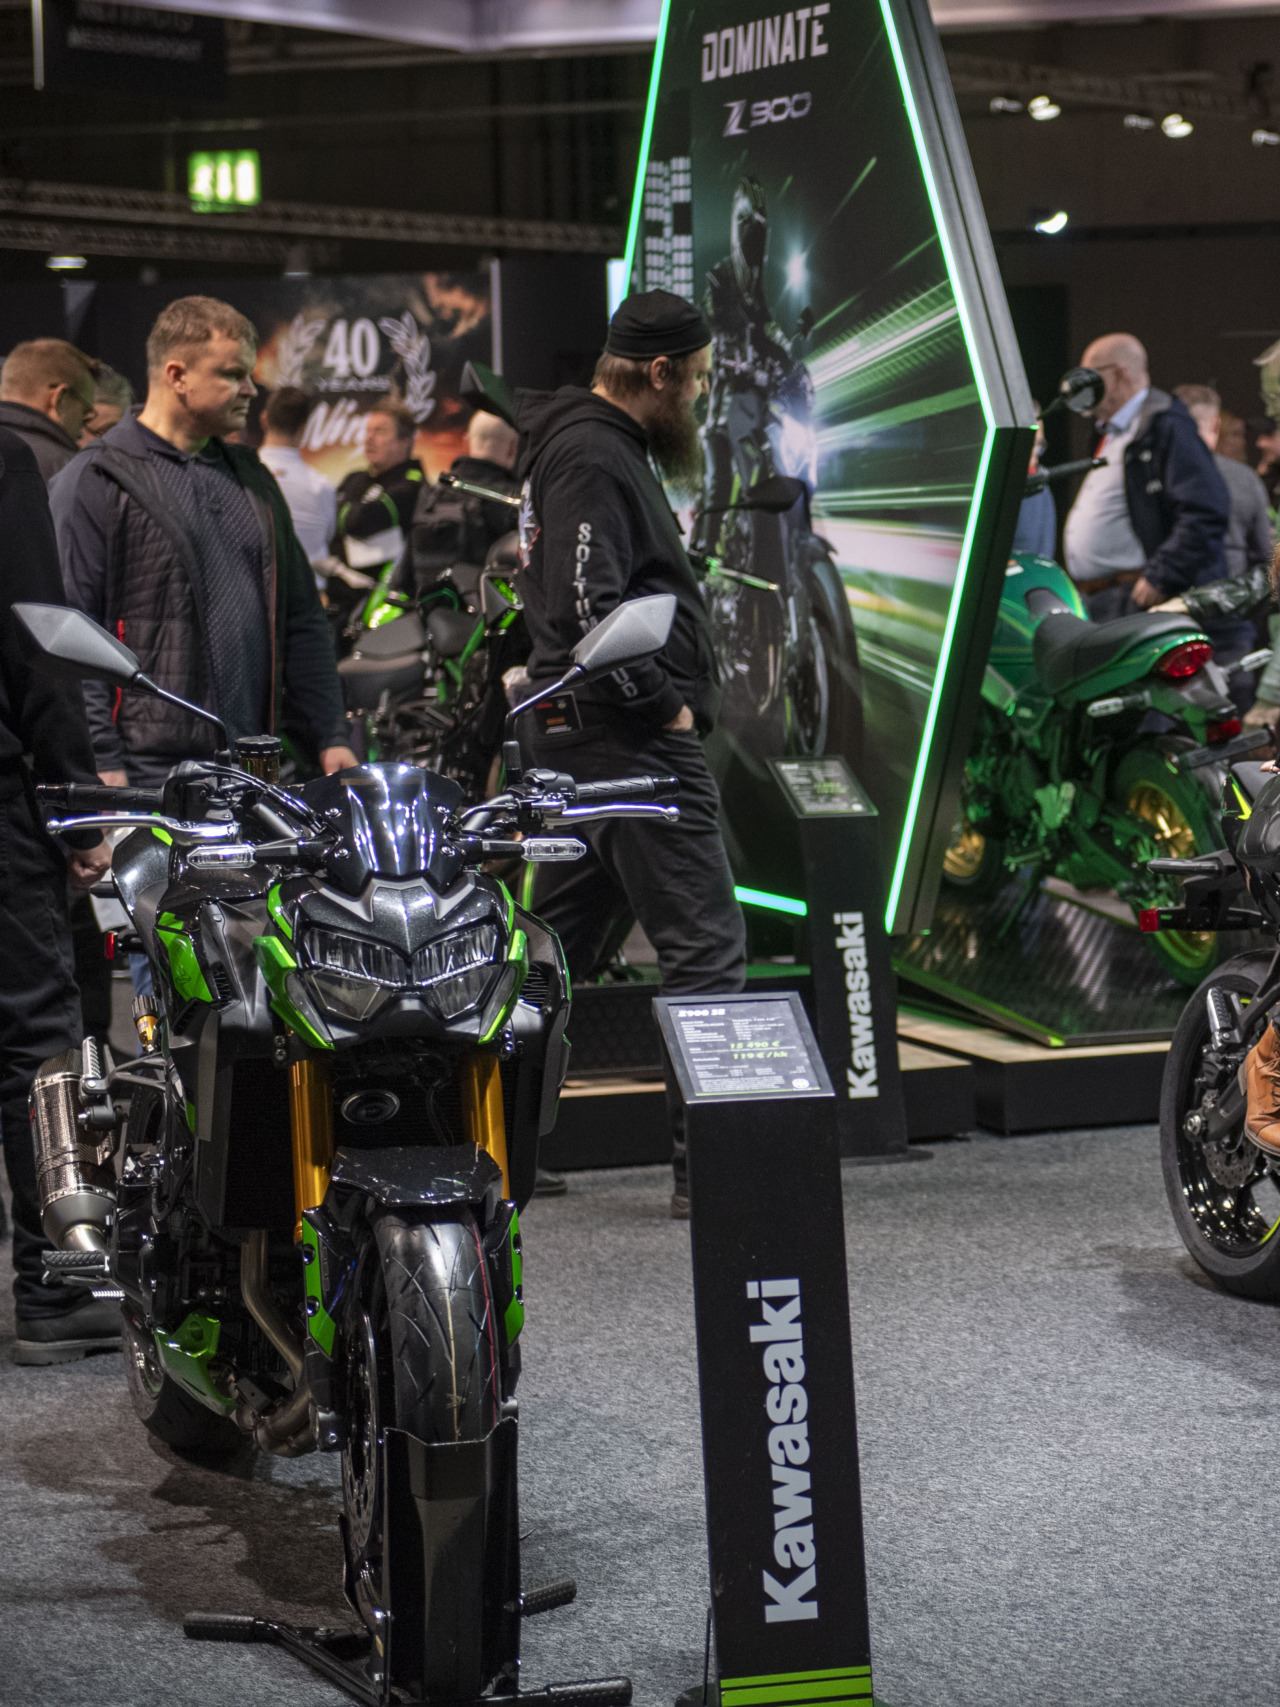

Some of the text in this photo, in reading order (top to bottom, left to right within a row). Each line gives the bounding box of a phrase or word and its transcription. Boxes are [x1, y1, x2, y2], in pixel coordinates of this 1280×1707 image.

[701, 2, 831, 83] DOMINATE
[323, 317, 380, 377] 40
[833, 911, 879, 1099] Kawasaki
[746, 1278, 819, 1623] Kawasaki
